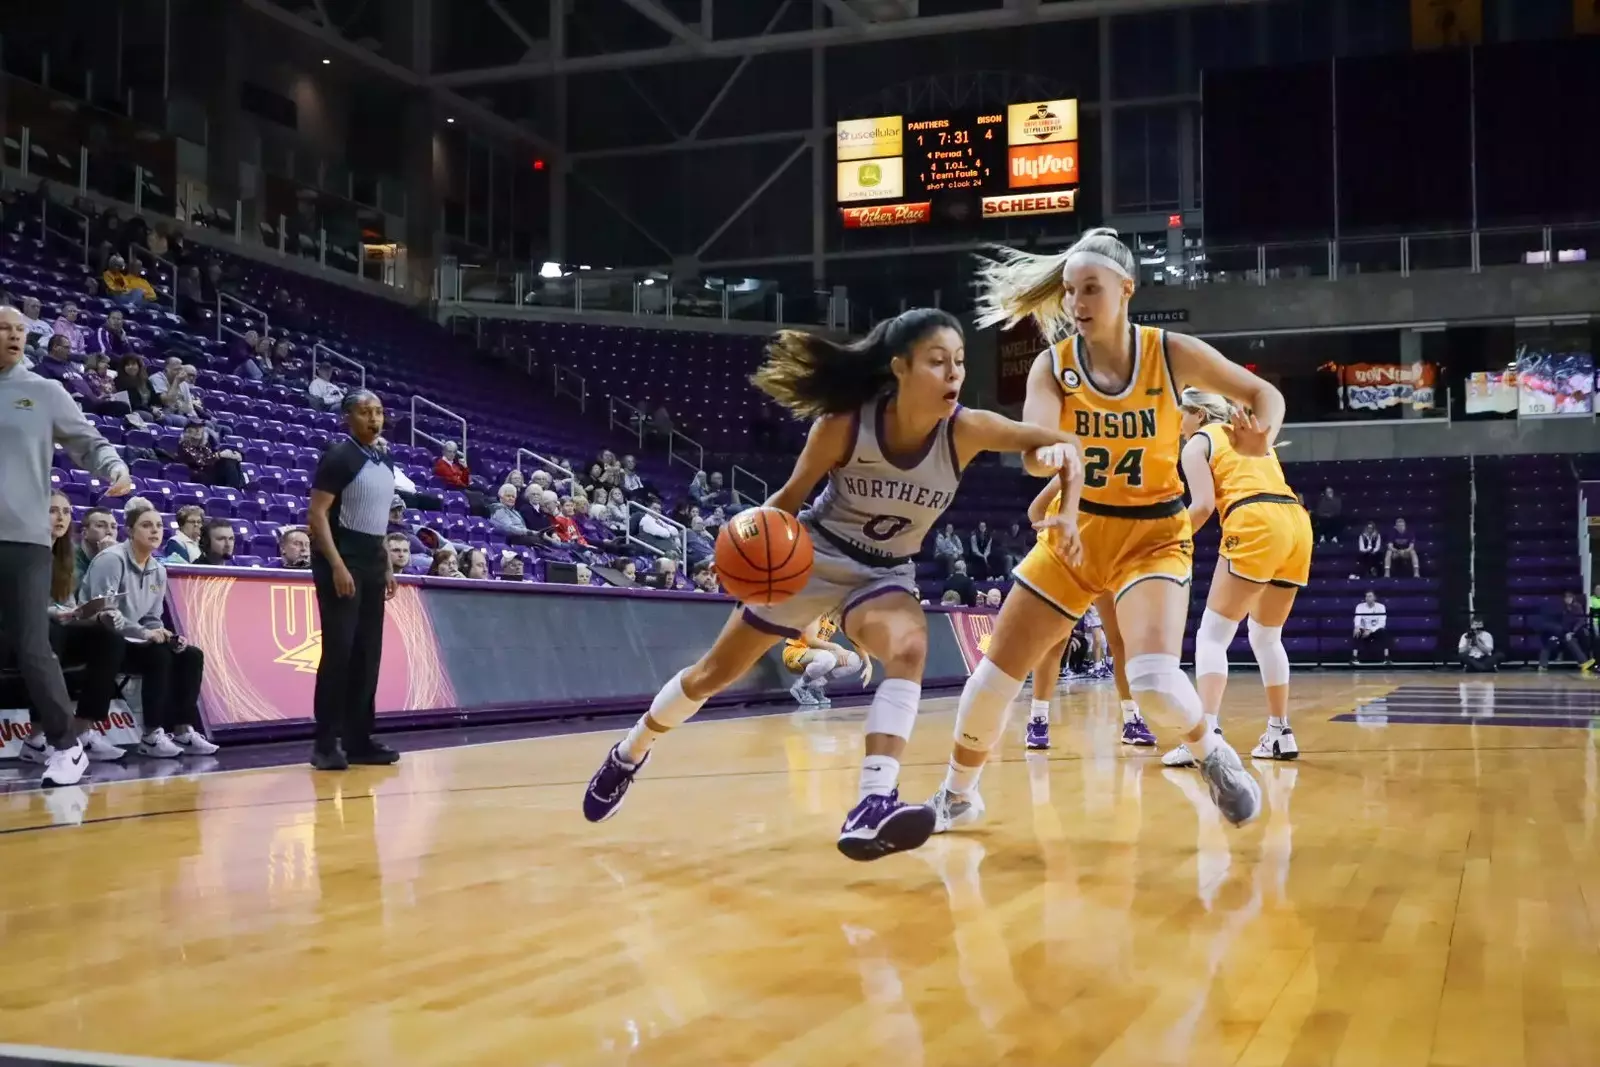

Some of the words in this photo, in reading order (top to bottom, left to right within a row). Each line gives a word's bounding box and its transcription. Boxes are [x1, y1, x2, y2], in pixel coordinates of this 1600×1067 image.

[908, 120, 950, 130] PANTHERS
[977, 115, 1002, 124] BISON
[938, 130, 969, 145] 7:31
[985, 129, 993, 139] 4
[917, 135, 923, 146] 1
[935, 150, 962, 159] Period
[967, 148, 972, 156] 1
[931, 163, 936, 171] 4
[975, 159, 981, 167] 4
[931, 172, 953, 180] Team
[955, 170, 978, 178] Fouls
[984, 168, 989, 176] 1
[984, 196, 1071, 214] SCHEELS
[859, 205, 893, 223] Other
[895, 205, 925, 219] Place
[1138, 312, 1185, 322] TERRACE
[1074, 408, 1156, 439] BISON
[1084, 447, 1144, 488] 24
